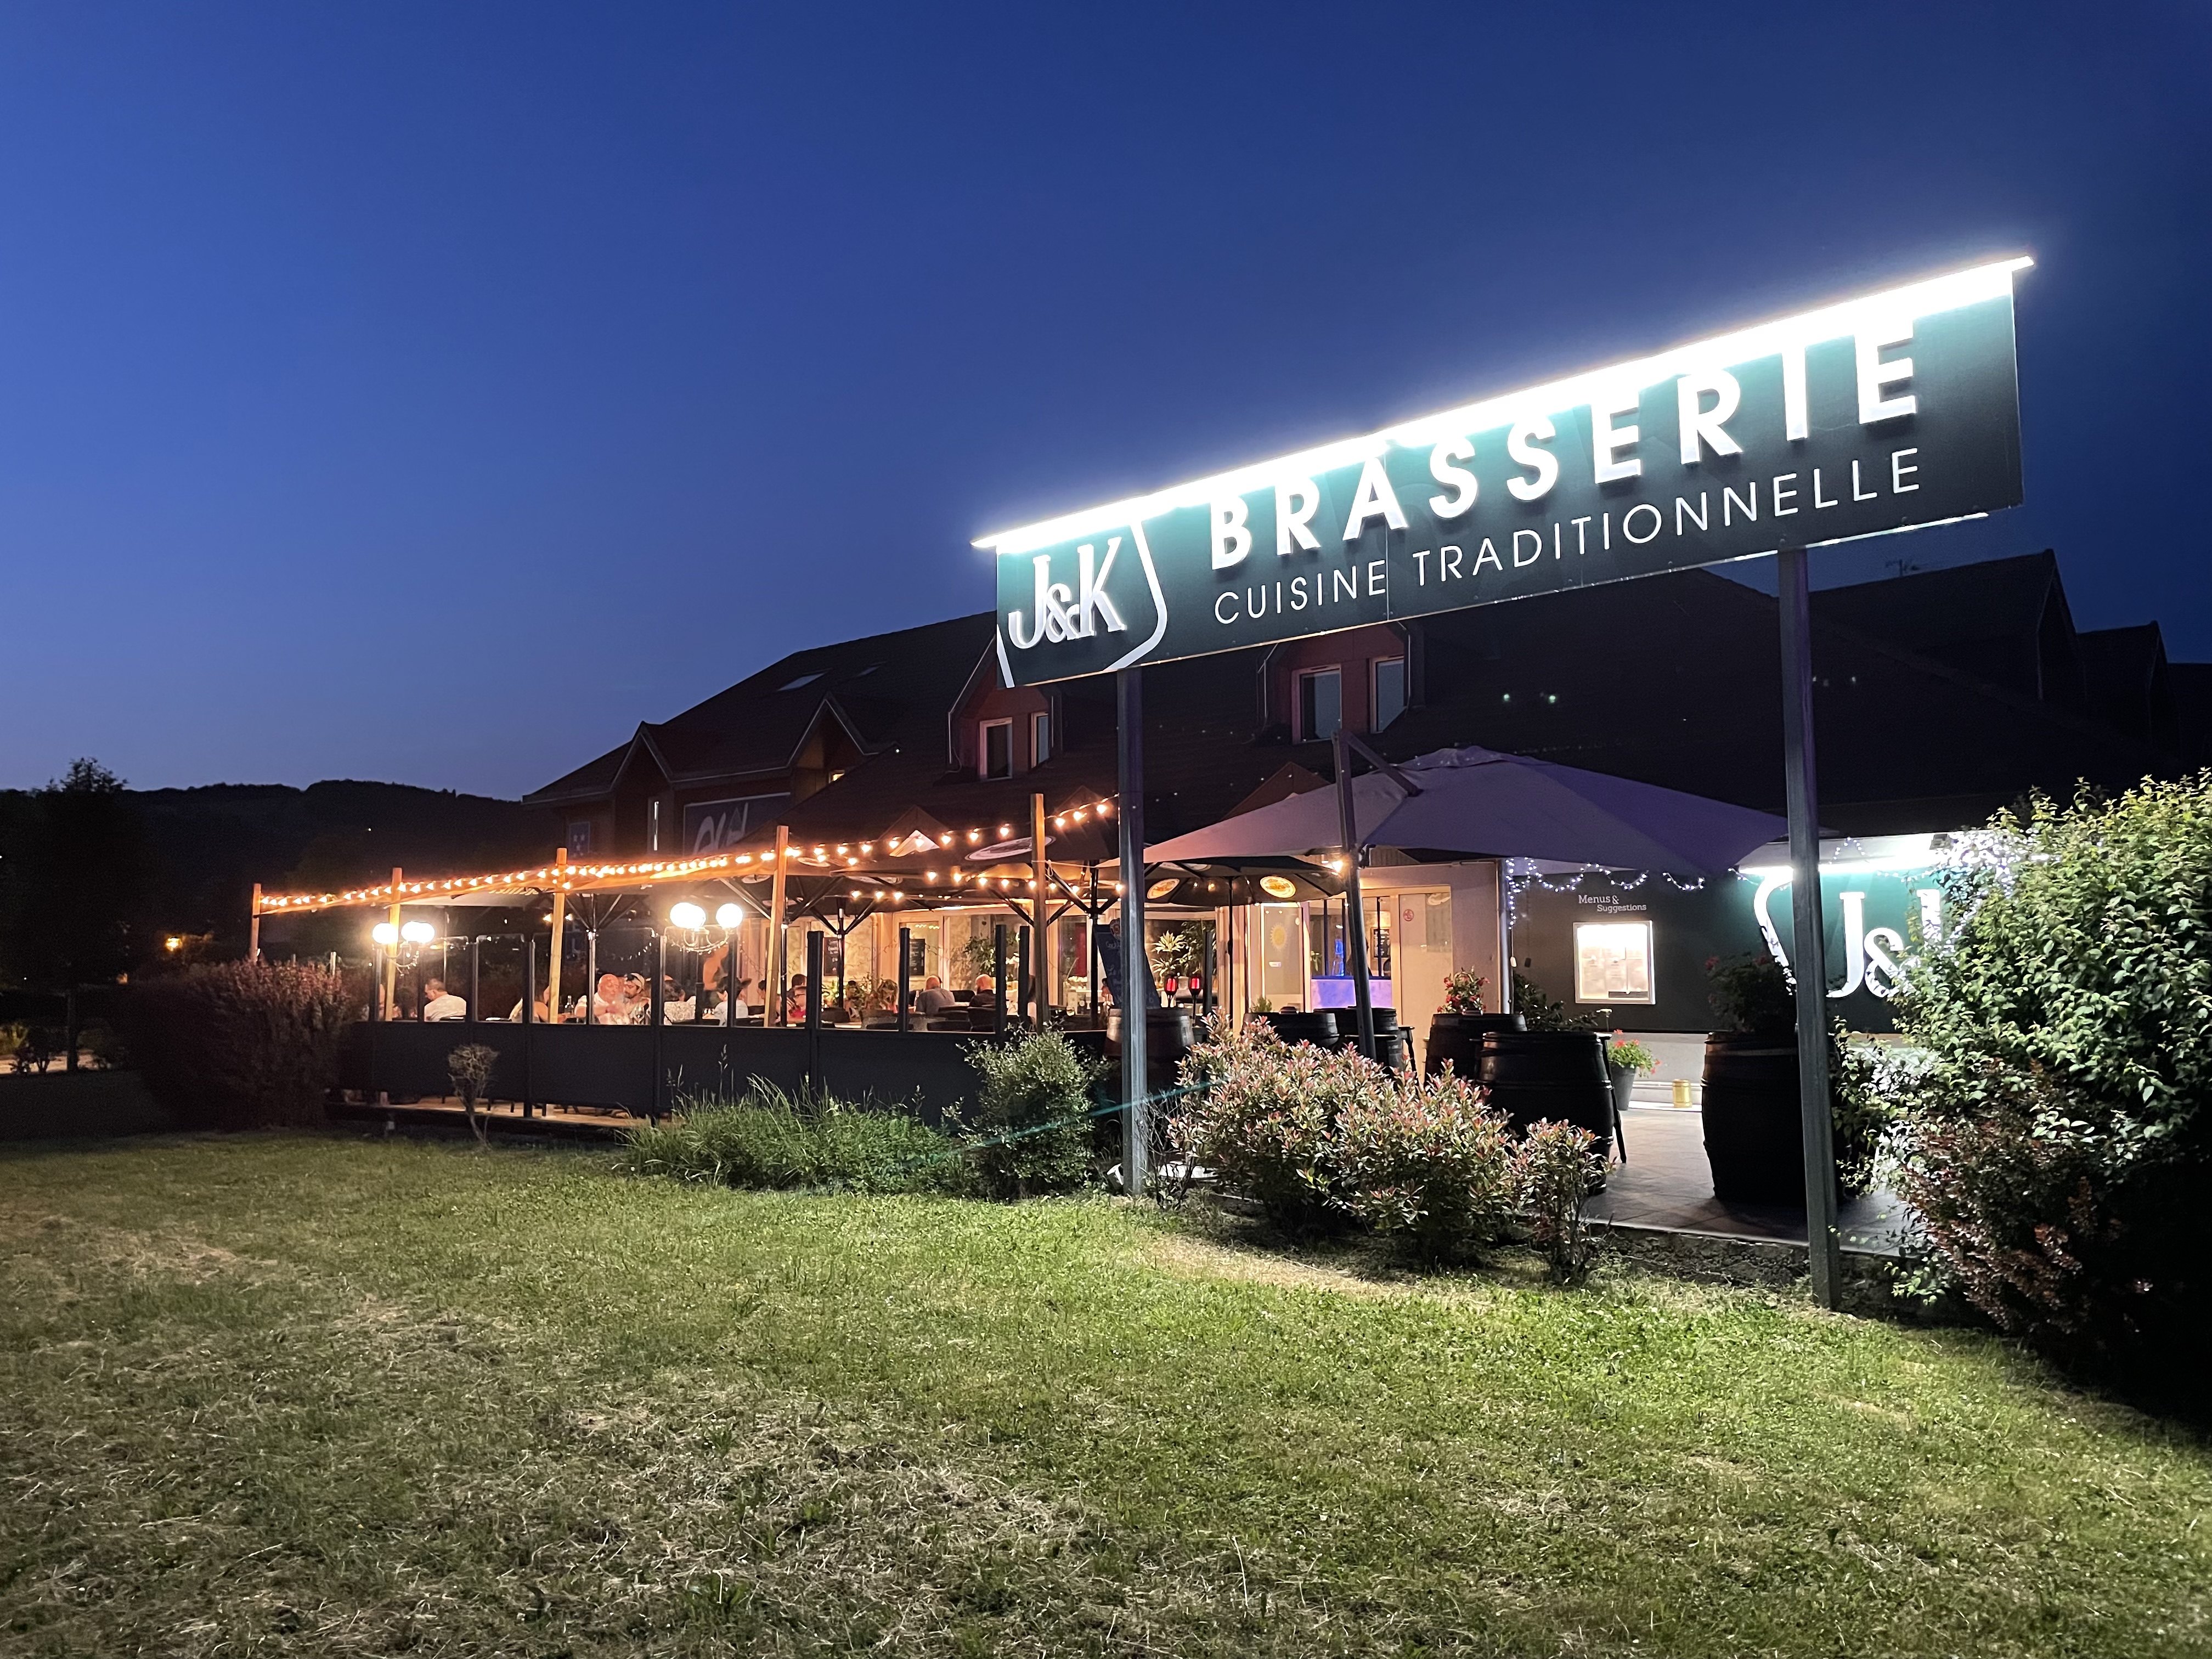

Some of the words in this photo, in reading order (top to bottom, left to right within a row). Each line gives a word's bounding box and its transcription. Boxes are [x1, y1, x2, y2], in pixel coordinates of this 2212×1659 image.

[1210, 320, 1916, 569] BRASSERIE
[1008, 536, 1127, 649] J&K
[1215, 559, 1386, 625] CUISINE
[1412, 447, 1920, 587] TRADITIONNELLE
[1578, 894, 1611, 904] Menus
[1612, 895, 1620, 905] &
[1596, 904, 1647, 913] Suggestions
